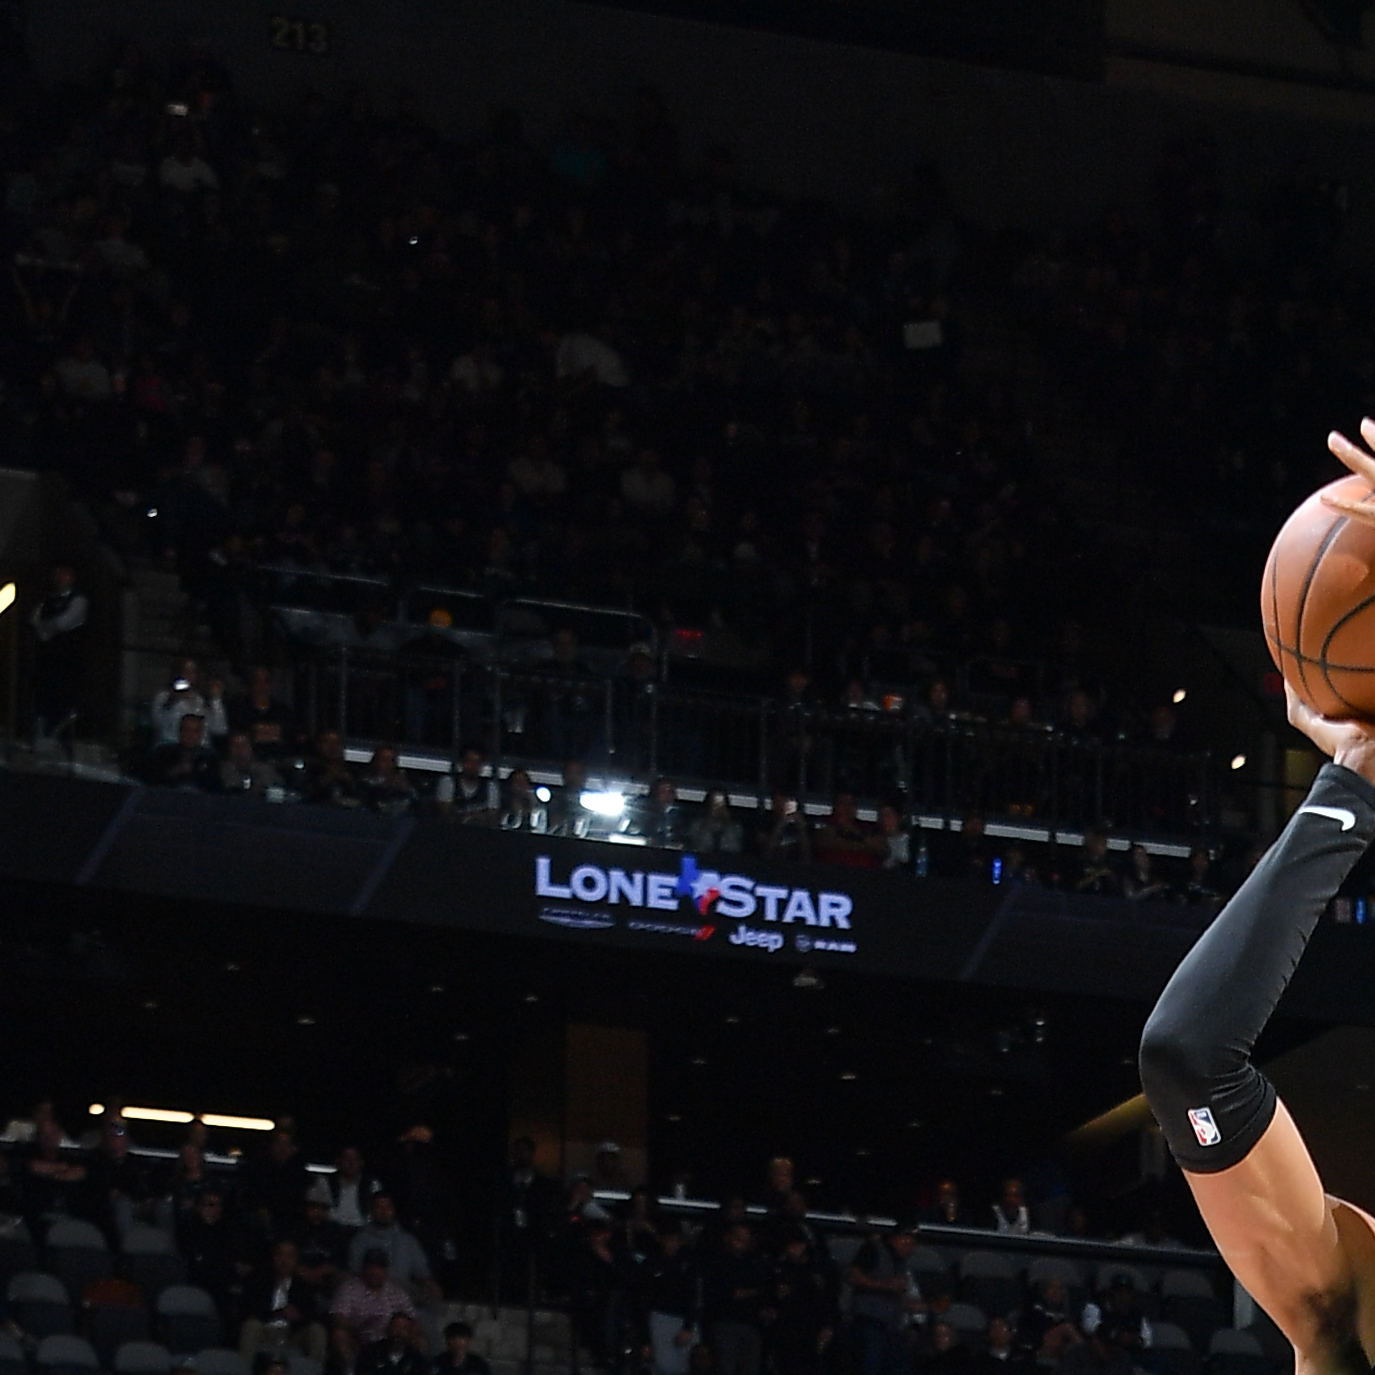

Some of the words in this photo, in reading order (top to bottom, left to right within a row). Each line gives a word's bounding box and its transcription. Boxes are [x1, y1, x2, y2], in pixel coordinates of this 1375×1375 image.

[269, 15, 328, 54] 213
[535, 856, 680, 911] LONE
[714, 876, 854, 930] STAR
[729, 924, 785, 953] Jeep
